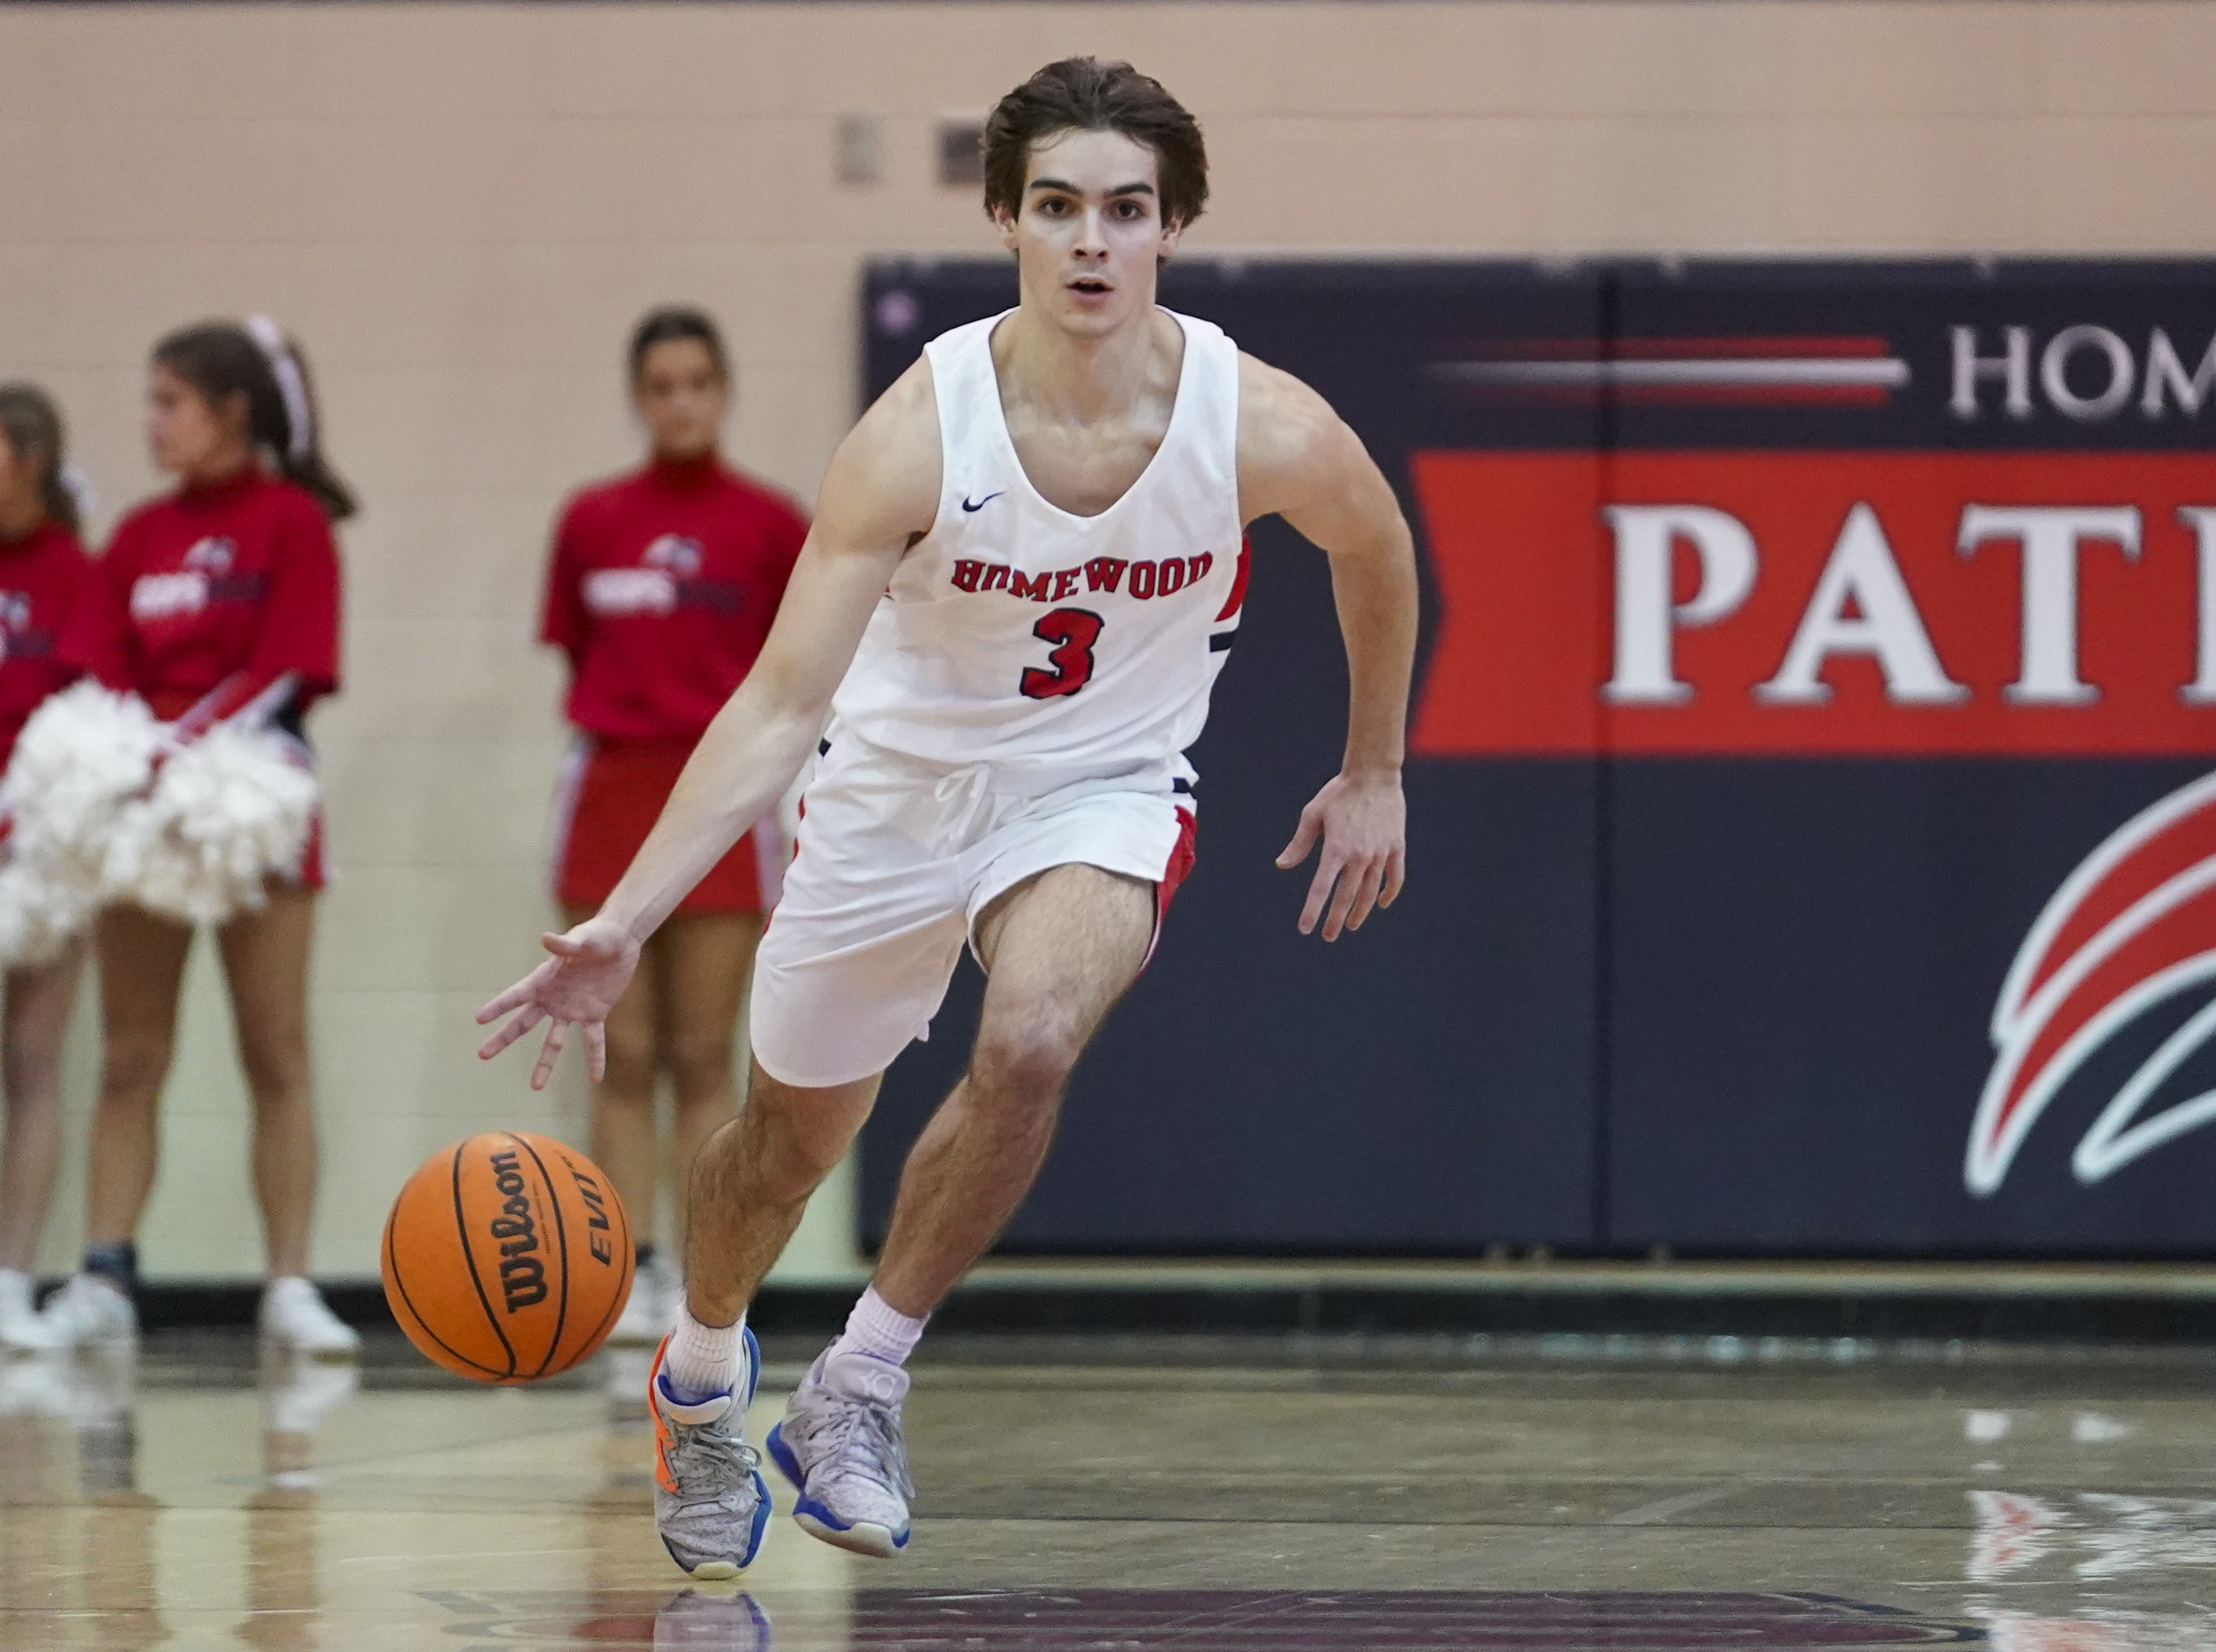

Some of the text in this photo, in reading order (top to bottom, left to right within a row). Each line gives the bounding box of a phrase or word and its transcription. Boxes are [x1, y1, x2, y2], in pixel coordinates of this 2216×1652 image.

[951, 550, 1213, 603] HOMEWOOD
[1597, 500, 2216, 706] PAT
[1019, 606, 1105, 700] 3
[489, 1150, 548, 1314] Wilson
